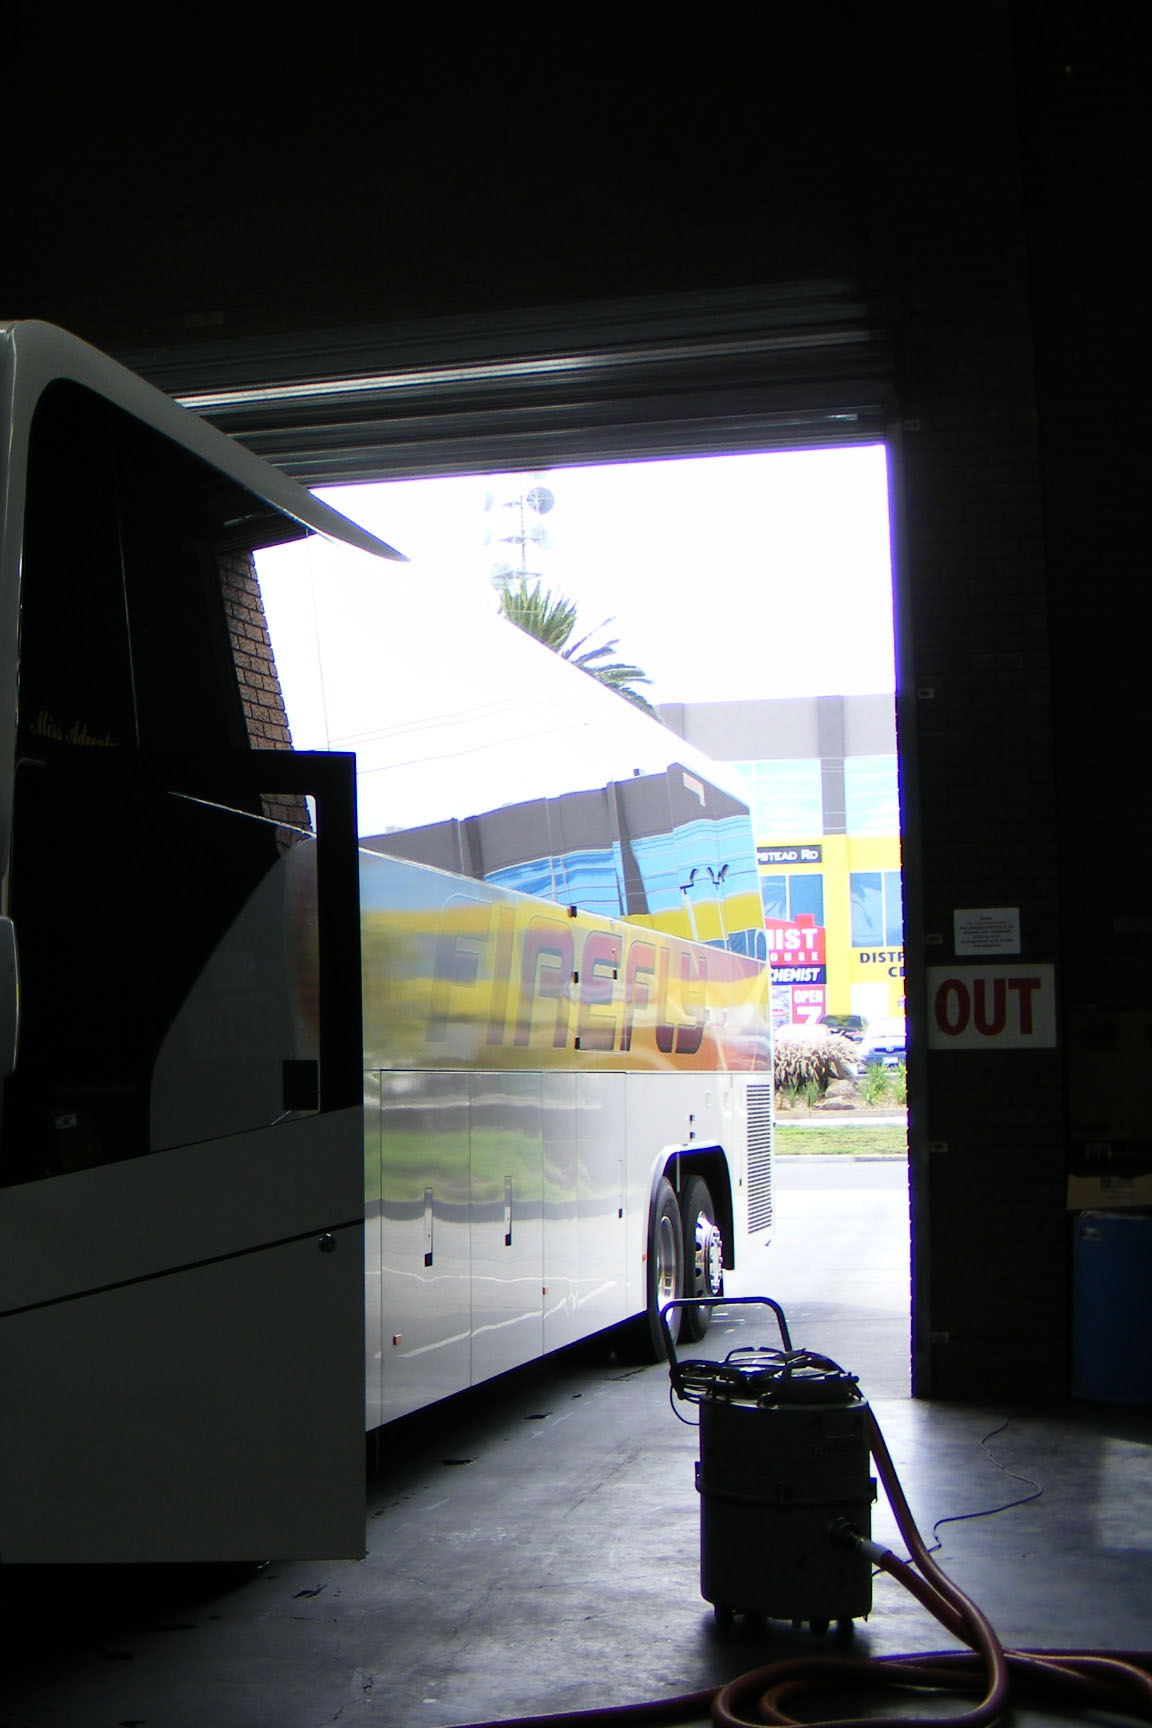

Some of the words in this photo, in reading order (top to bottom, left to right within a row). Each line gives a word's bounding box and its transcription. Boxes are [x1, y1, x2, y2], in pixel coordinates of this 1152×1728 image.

[425, 893, 708, 1055] FIREFLY
[793, 989, 823, 1004] OPEN
[934, 977, 1042, 1036] OUT
